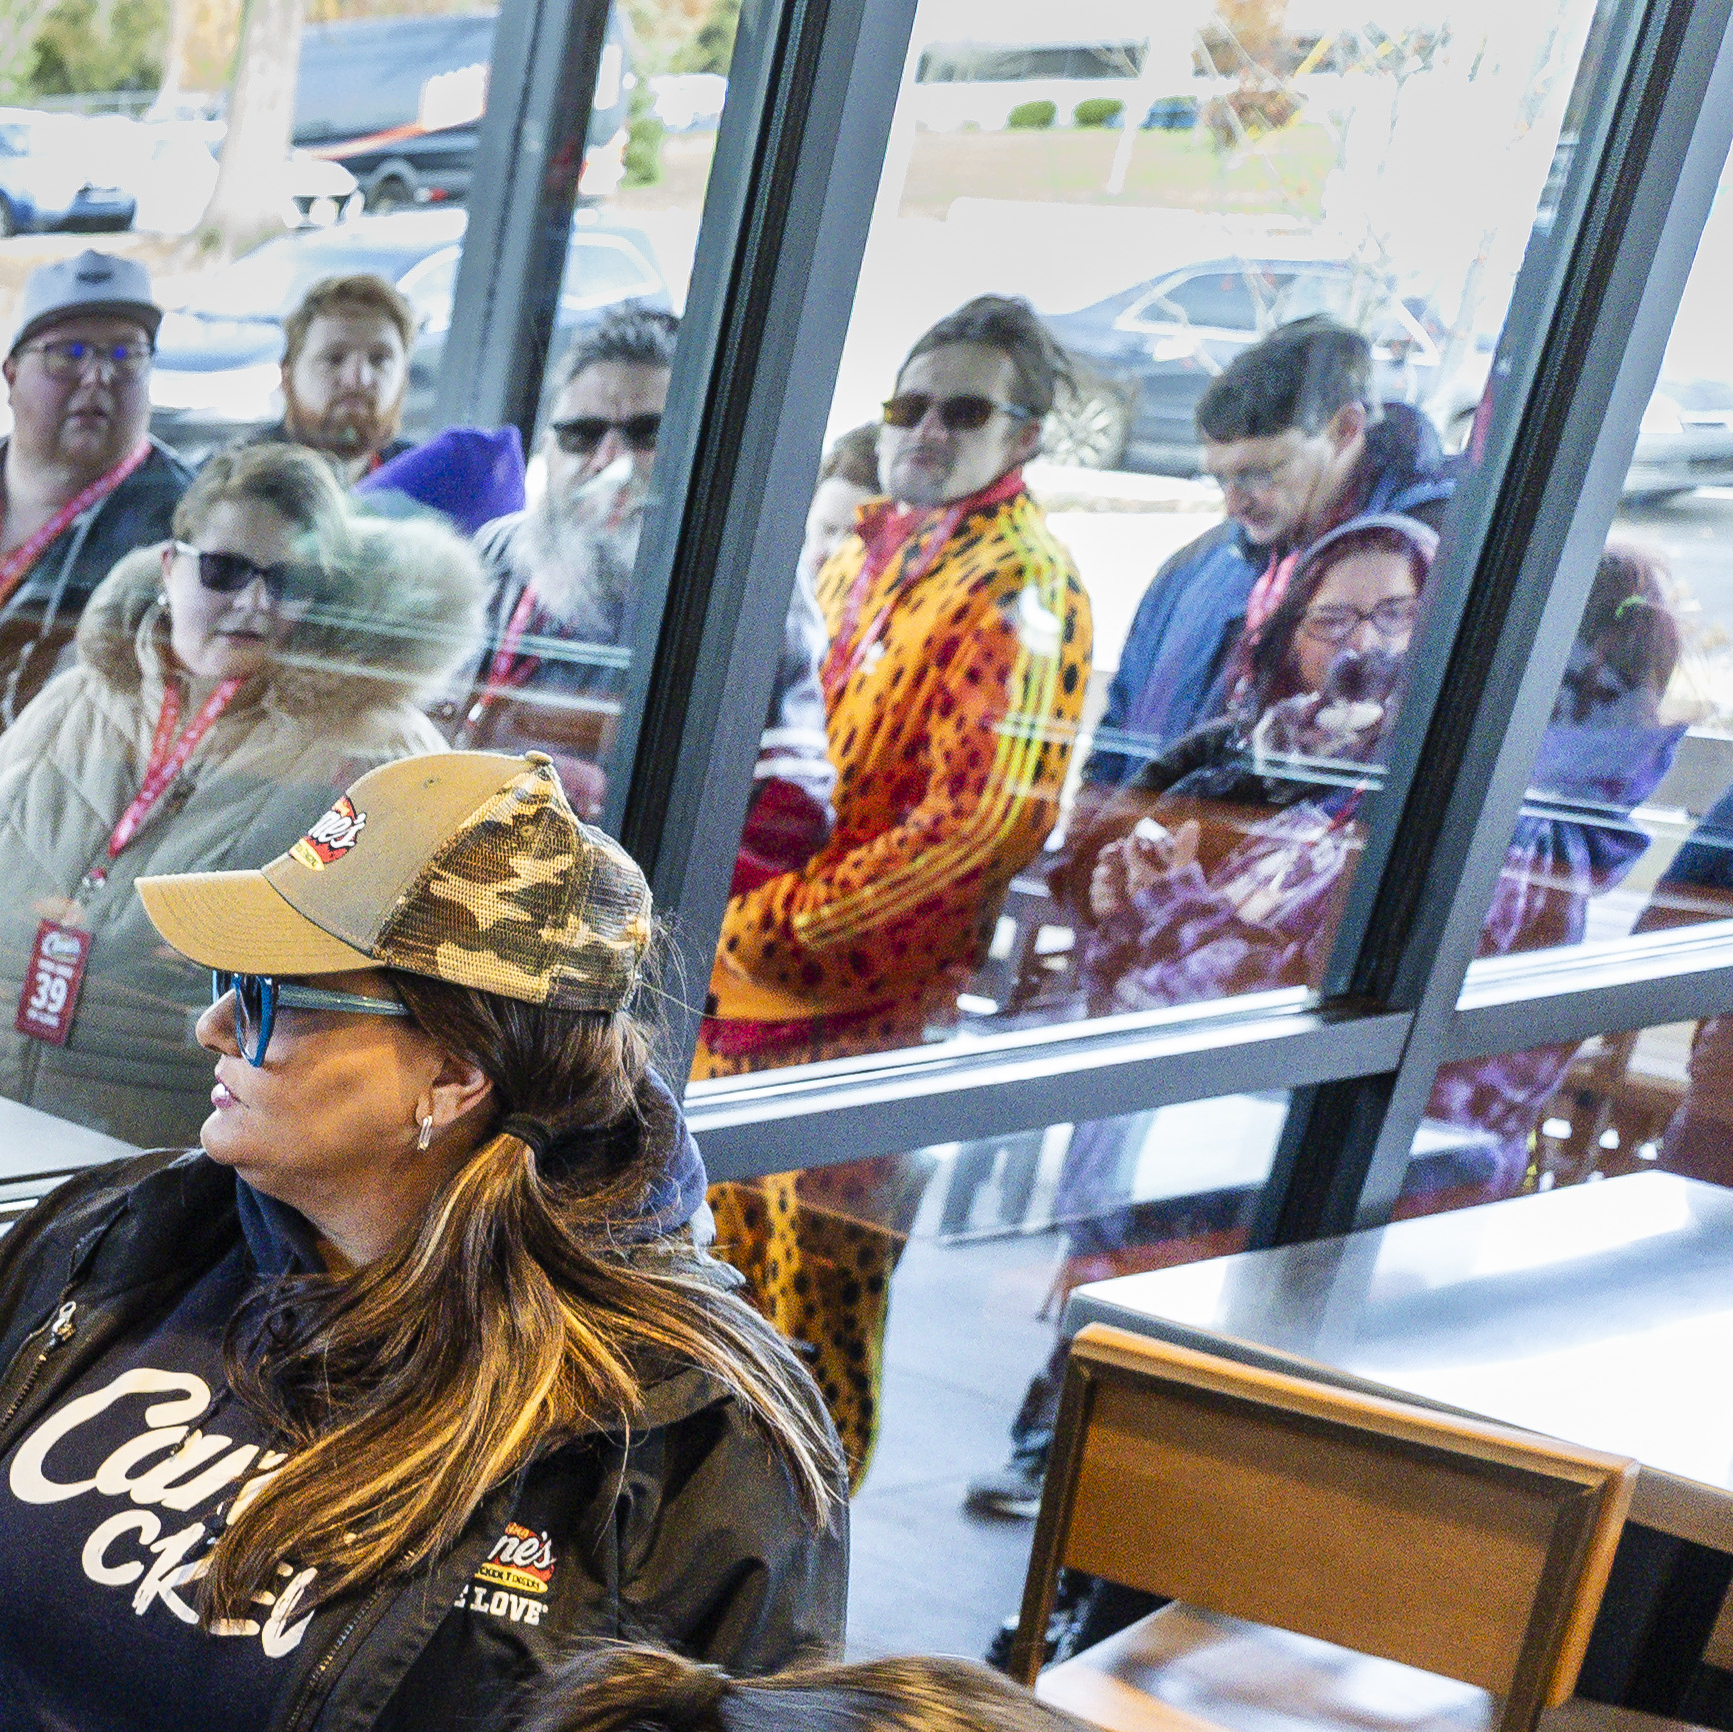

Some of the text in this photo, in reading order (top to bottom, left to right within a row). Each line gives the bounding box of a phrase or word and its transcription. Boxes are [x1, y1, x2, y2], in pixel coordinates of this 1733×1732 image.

[307, 811, 367, 849] ne's
[30, 972, 68, 1013] 39
[486, 1530, 556, 1570] ne's
